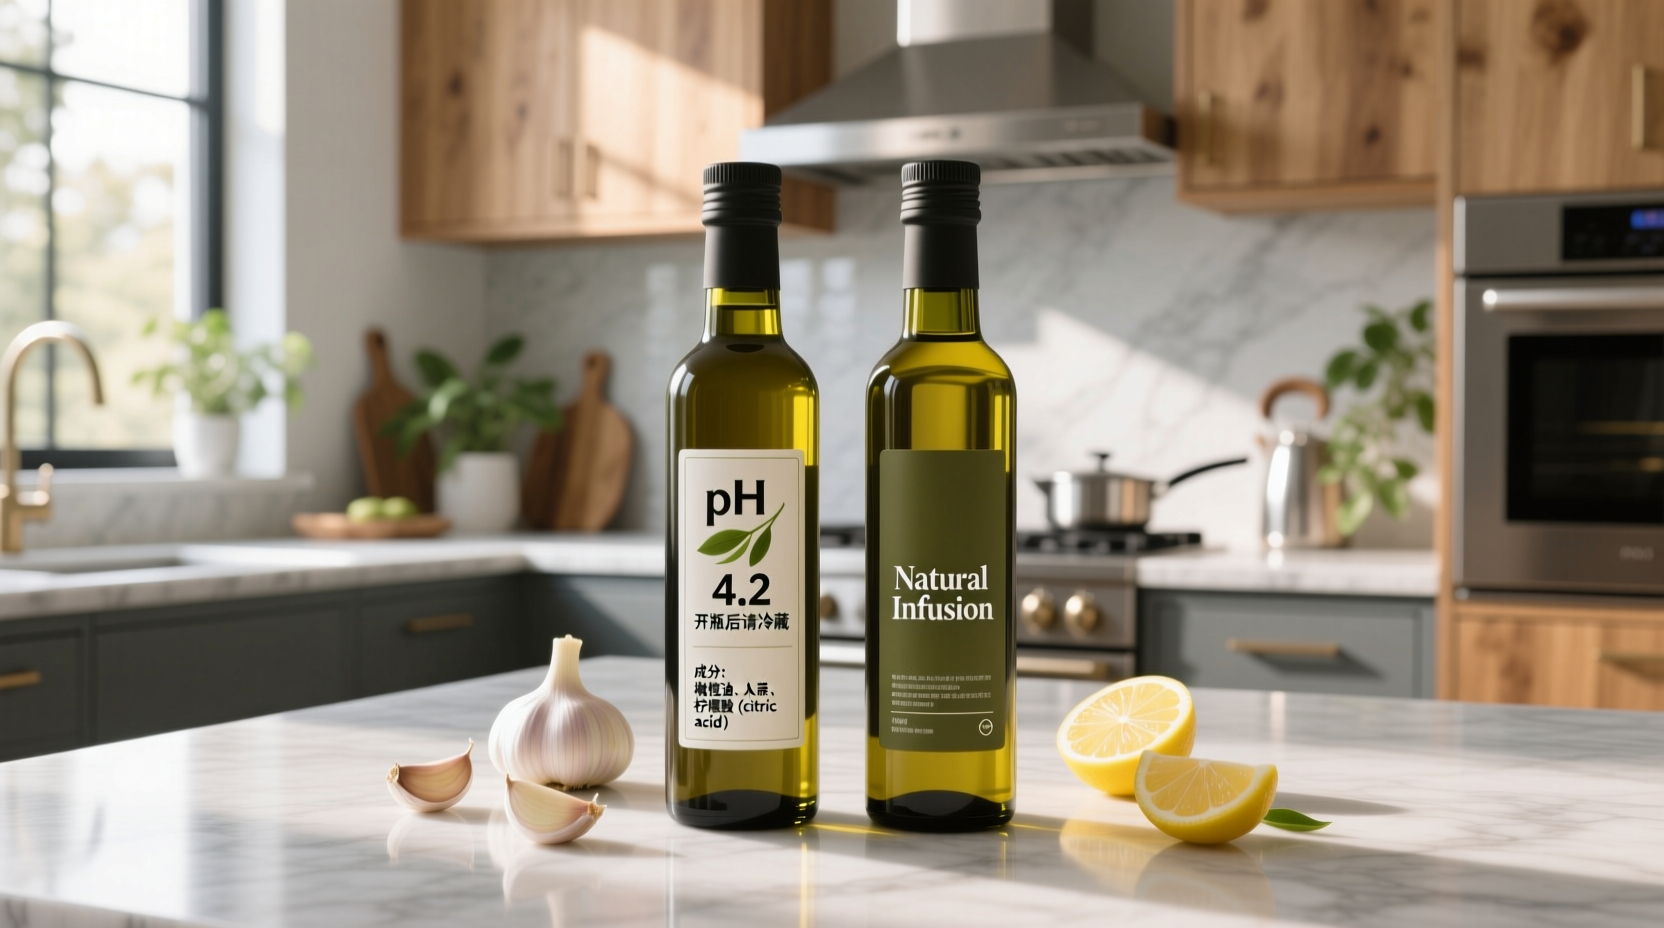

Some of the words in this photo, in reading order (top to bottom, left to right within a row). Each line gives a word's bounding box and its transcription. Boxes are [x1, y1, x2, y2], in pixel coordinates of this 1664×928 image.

[706, 479, 765, 527] pH
[712, 573, 771, 606] 4.2
[893, 564, 989, 591] Natural
[892, 594, 995, 621] Infusion
[738, 699, 778, 716] (citric
[694, 715, 729, 731] acid)
